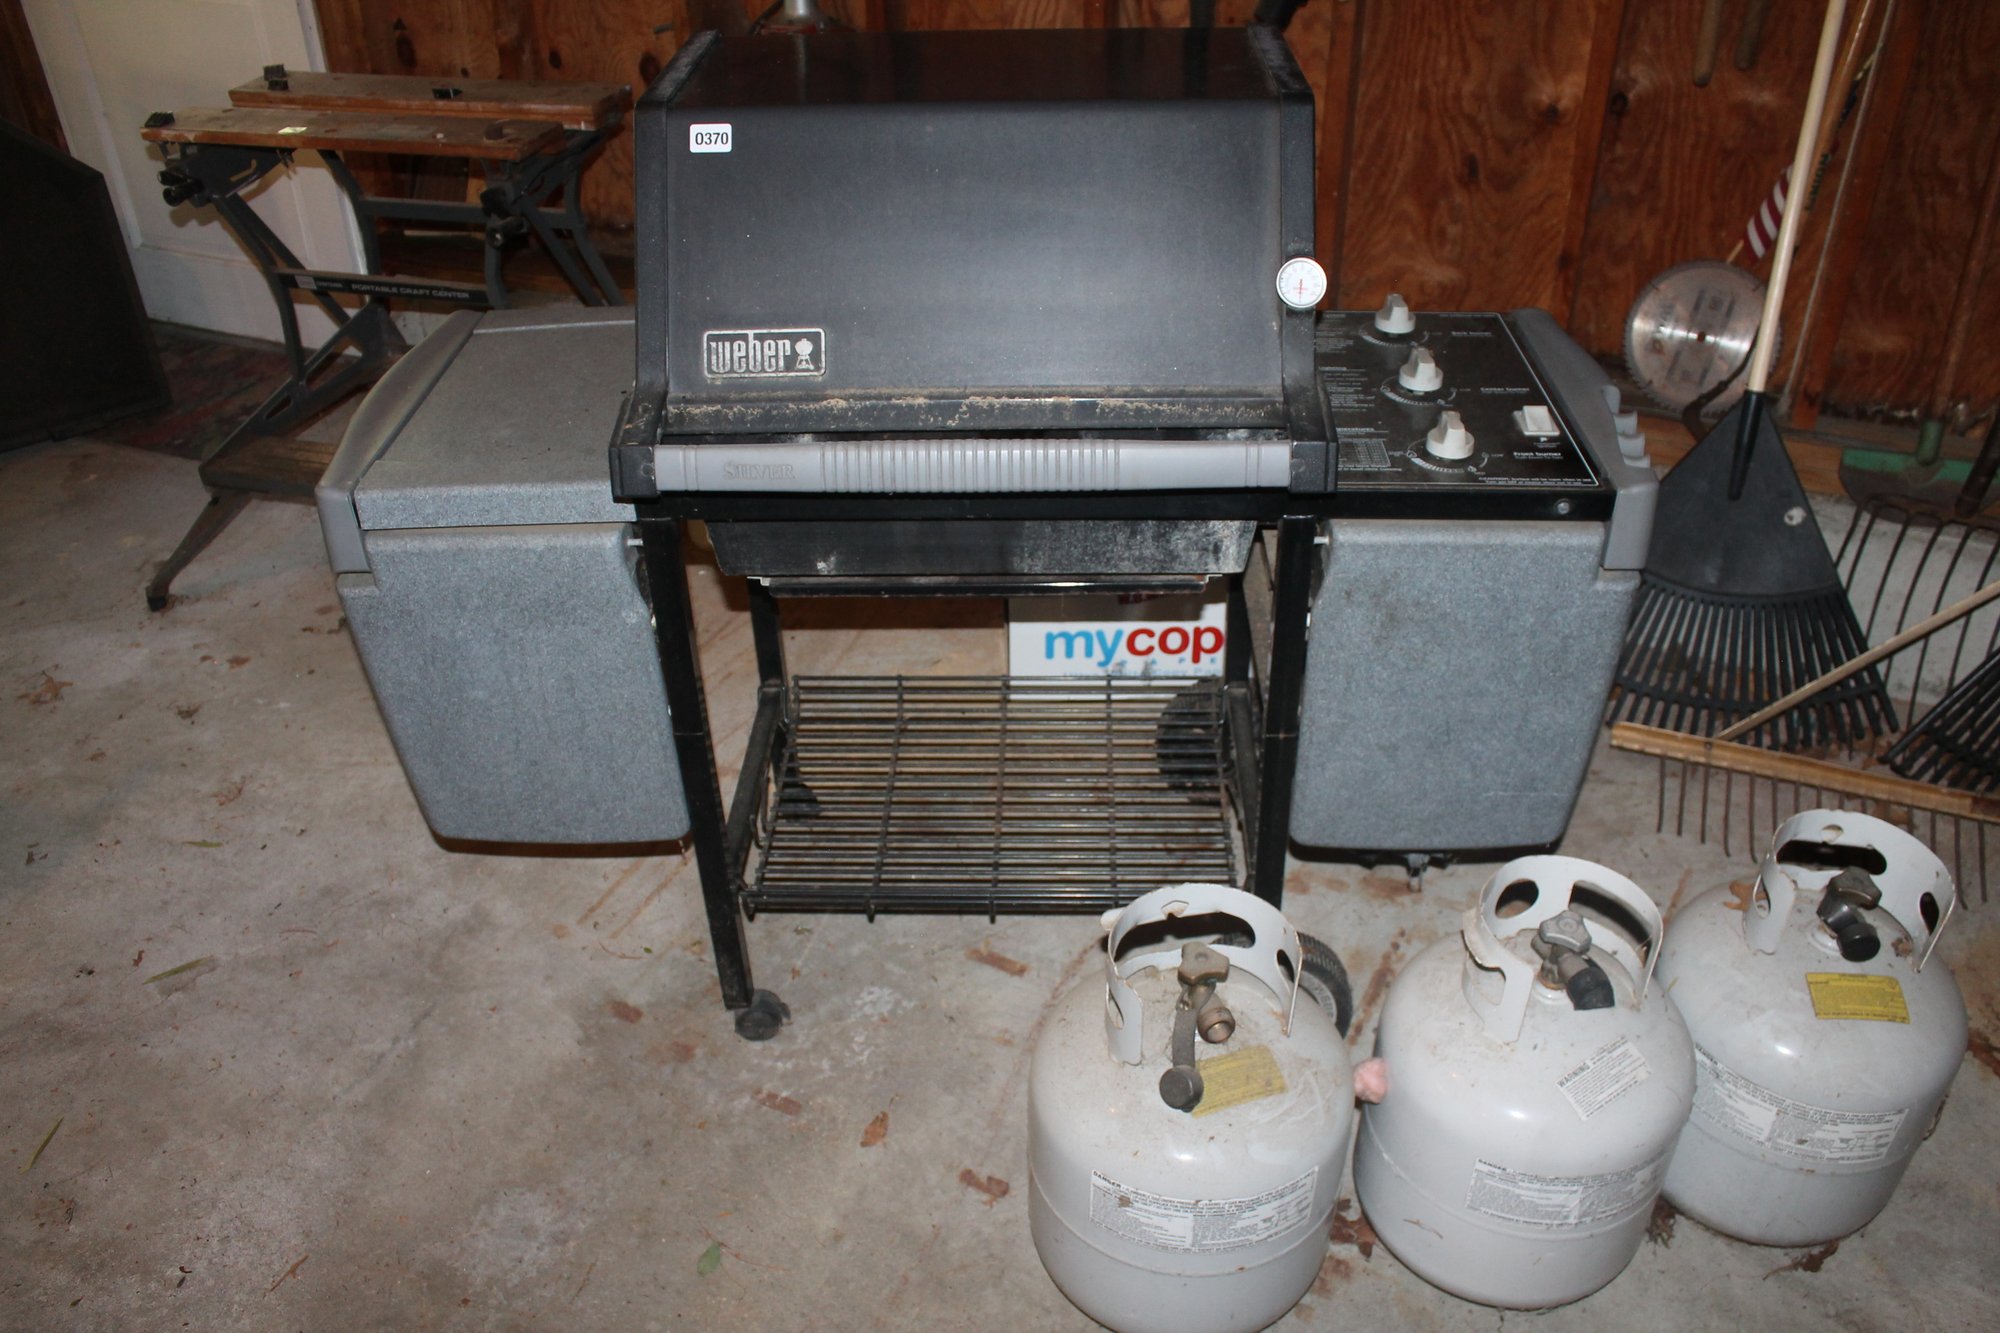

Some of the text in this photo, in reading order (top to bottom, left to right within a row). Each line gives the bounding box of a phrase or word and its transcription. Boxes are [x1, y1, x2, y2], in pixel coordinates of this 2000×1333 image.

[694, 131, 729, 146] 0370
[351, 283, 399, 294] PORTABLE
[431, 289, 470, 299] CENTER
[709, 332, 791, 374] weber
[1556, 1065, 1592, 1087] WARNING
[1093, 1170, 1122, 1189] DANGER
